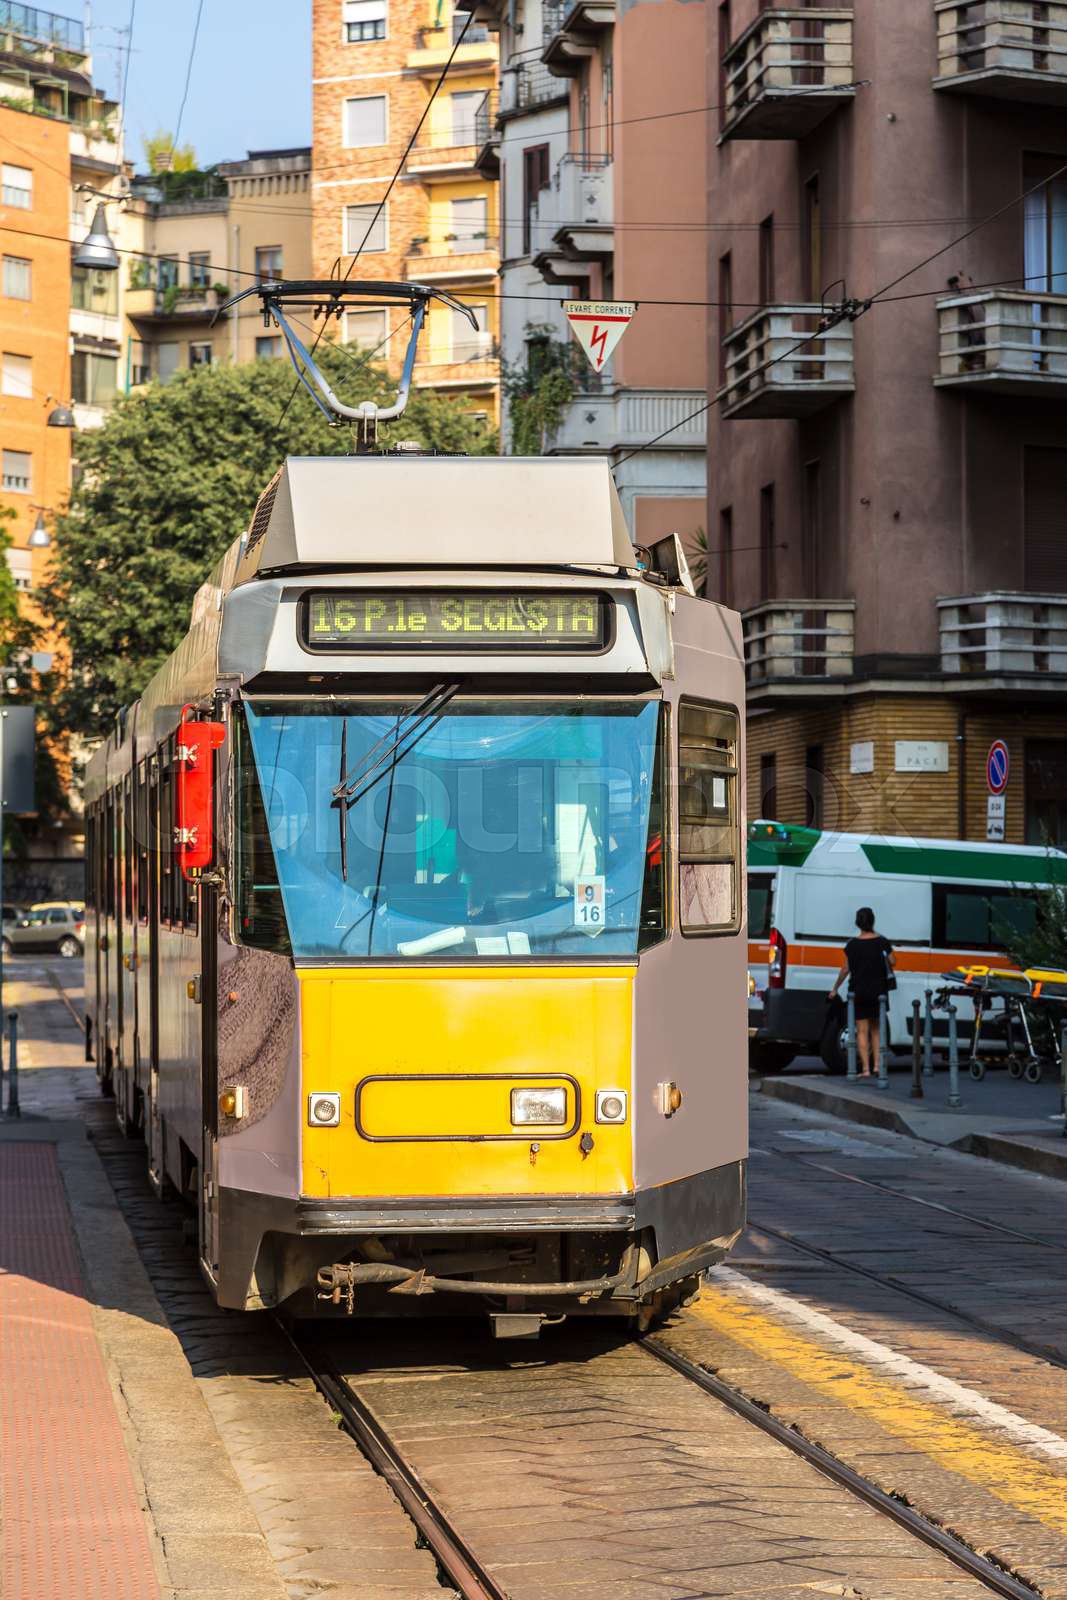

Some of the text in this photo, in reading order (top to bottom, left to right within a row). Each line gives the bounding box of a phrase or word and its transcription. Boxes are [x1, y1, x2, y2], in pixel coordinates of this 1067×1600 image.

[566, 304, 633, 315] LEVARE CORRENTE
[314, 600, 594, 631] 16 P.le SEGESTA
[585, 885, 594, 902] 9
[580, 906, 600, 922] 16
